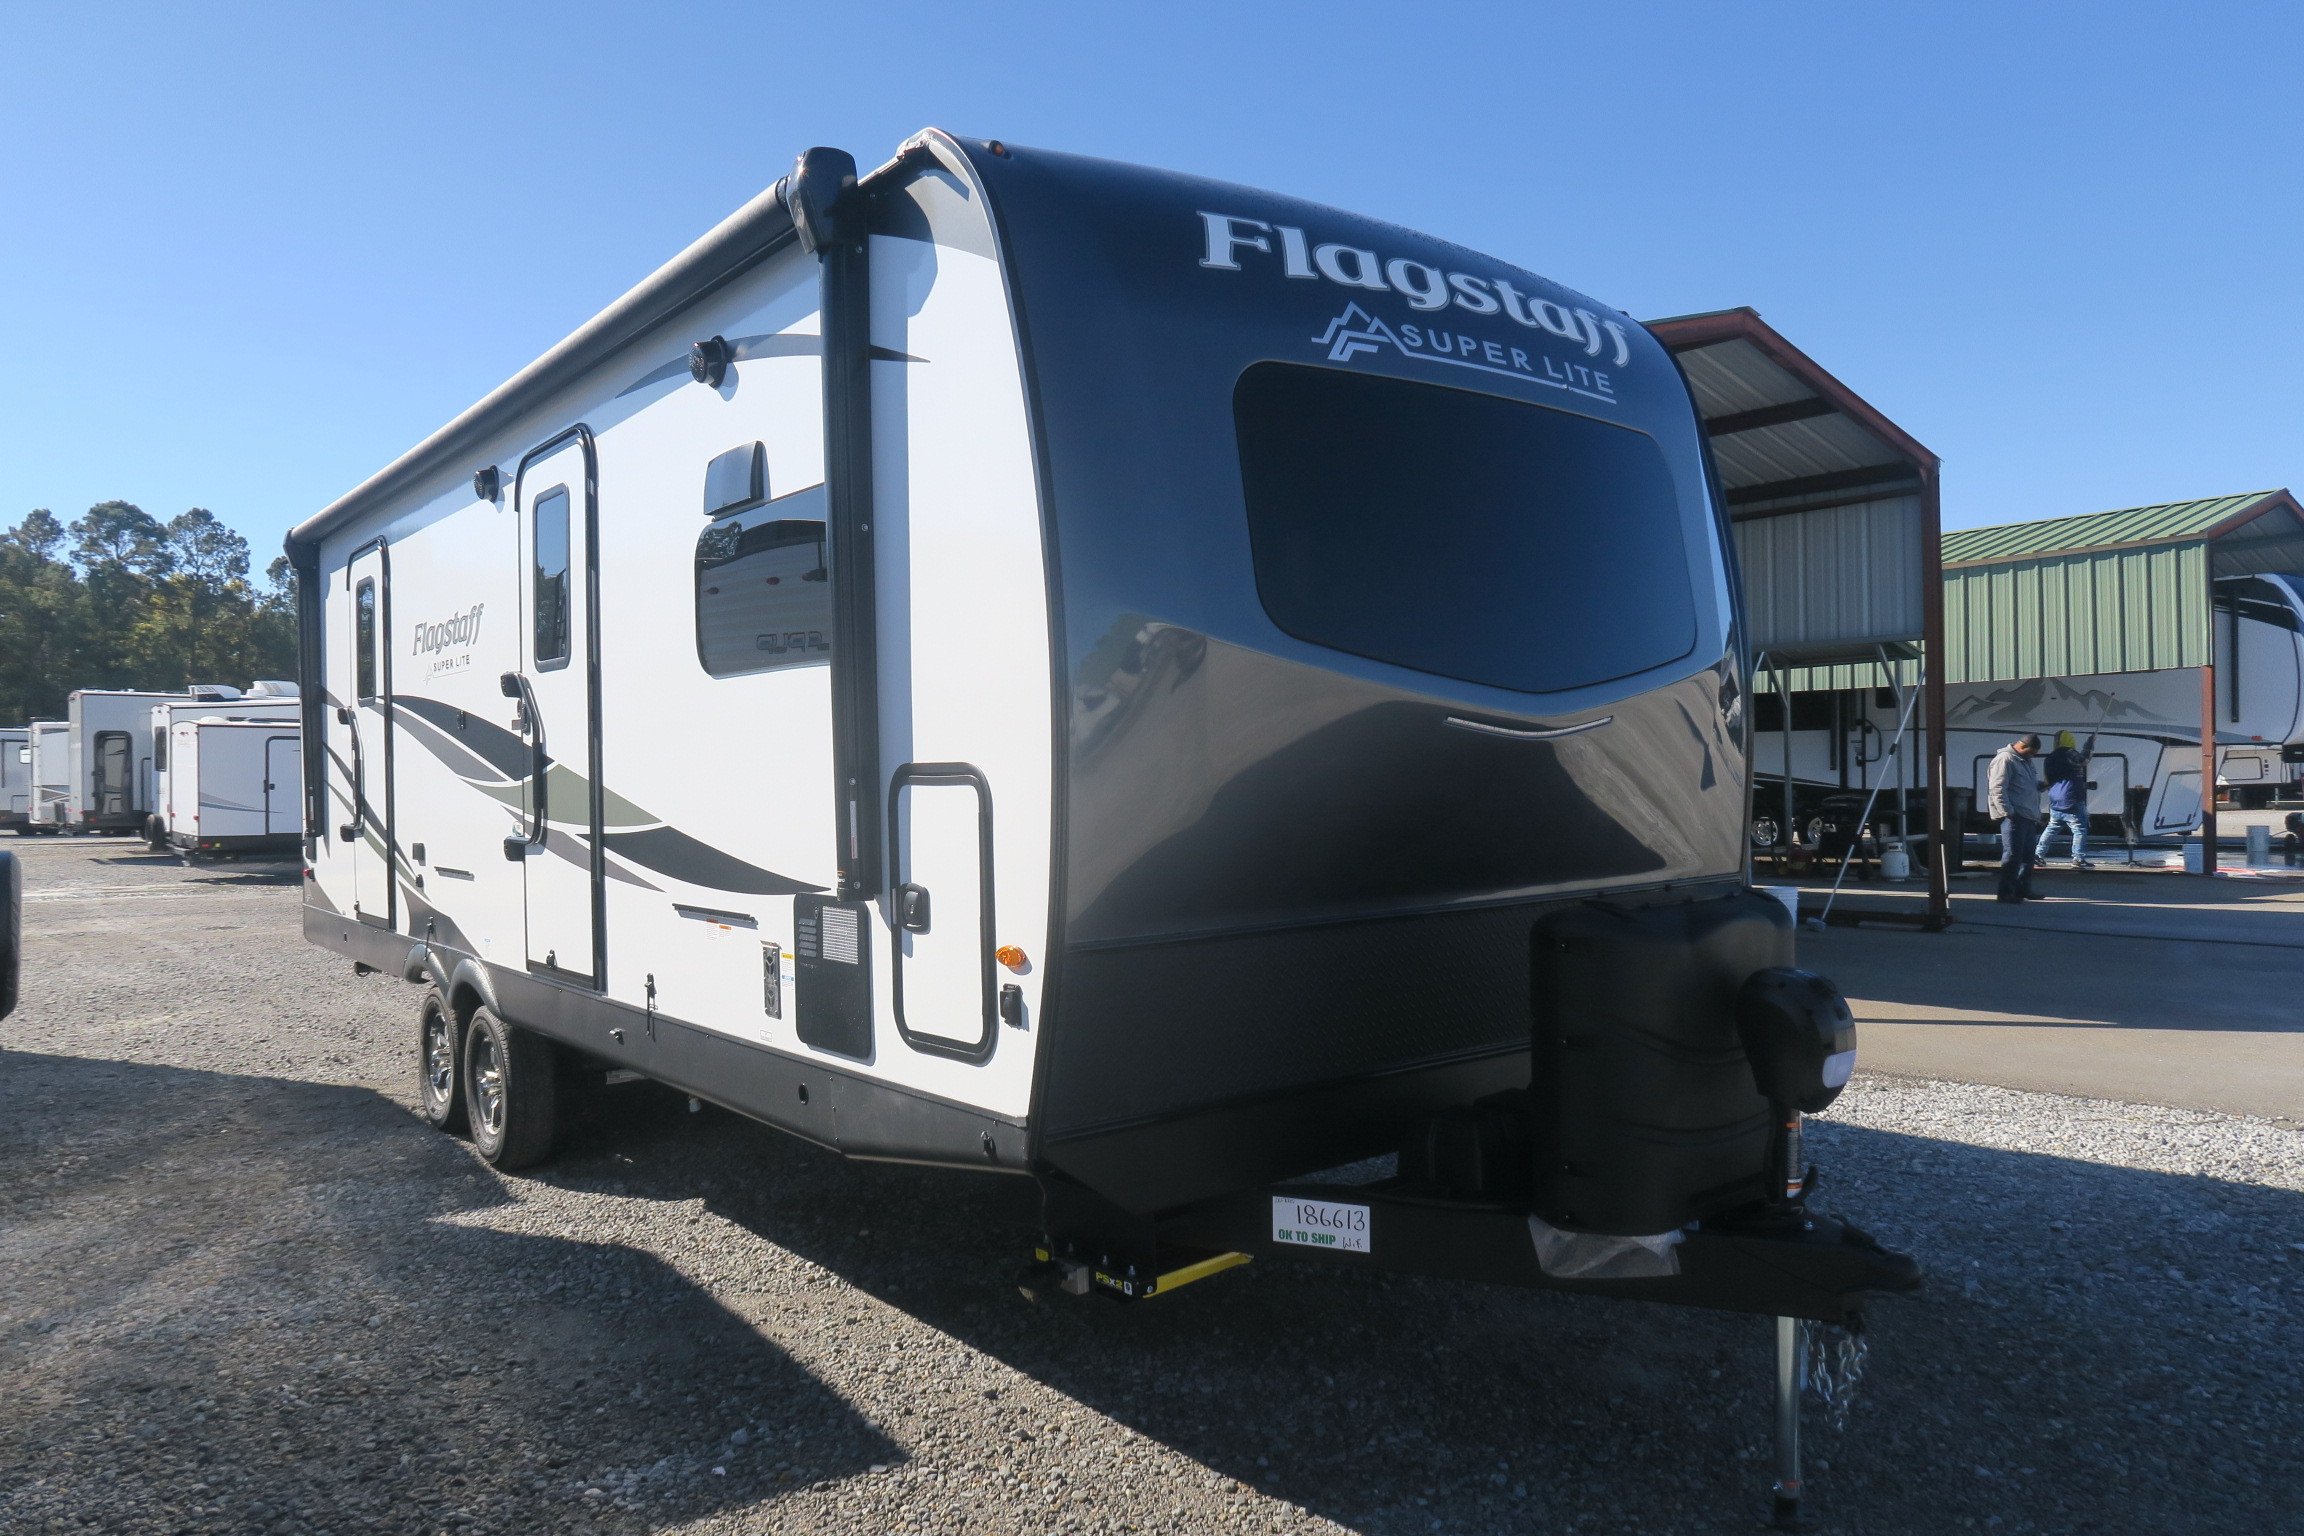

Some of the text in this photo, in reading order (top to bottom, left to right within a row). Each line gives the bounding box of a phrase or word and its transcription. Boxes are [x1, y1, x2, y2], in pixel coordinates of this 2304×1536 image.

[1196, 209, 1631, 368] Flagstaff
[1400, 323, 1614, 394] SUPER LITE
[412, 602, 484, 656] Flagstaff
[433, 654, 471, 672] SUPER LITE
[1278, 1228, 1336, 1245] OK TO SHIP
[1296, 1204, 1365, 1231] 186613
